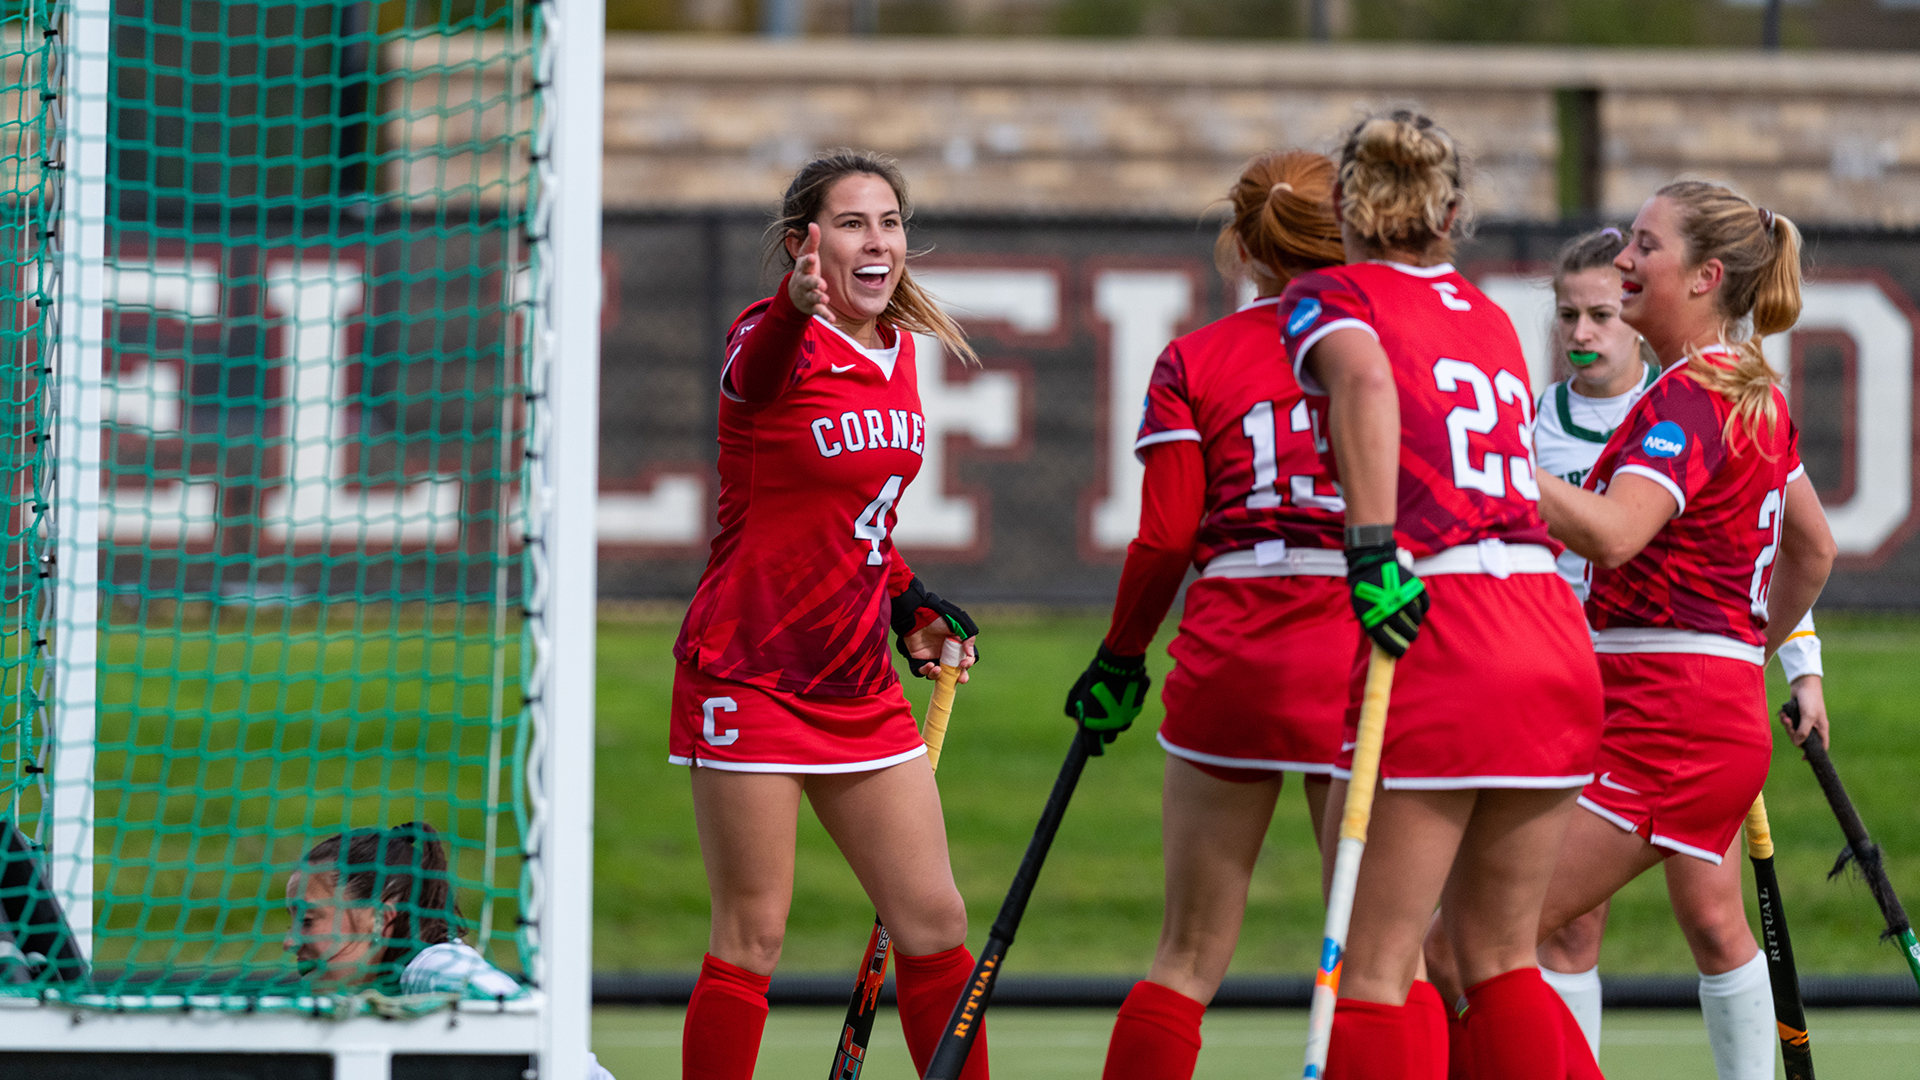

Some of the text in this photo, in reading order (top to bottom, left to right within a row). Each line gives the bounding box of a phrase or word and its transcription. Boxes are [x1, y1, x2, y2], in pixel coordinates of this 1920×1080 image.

[810, 408, 927, 459] CORNE
[1432, 357, 1541, 501] 23
[853, 473, 904, 566] 4
[1749, 487, 1788, 623] 2
[701, 695, 739, 746] C
[1760, 887, 1781, 962] RITUAL
[953, 954, 999, 1039] RITUAL
